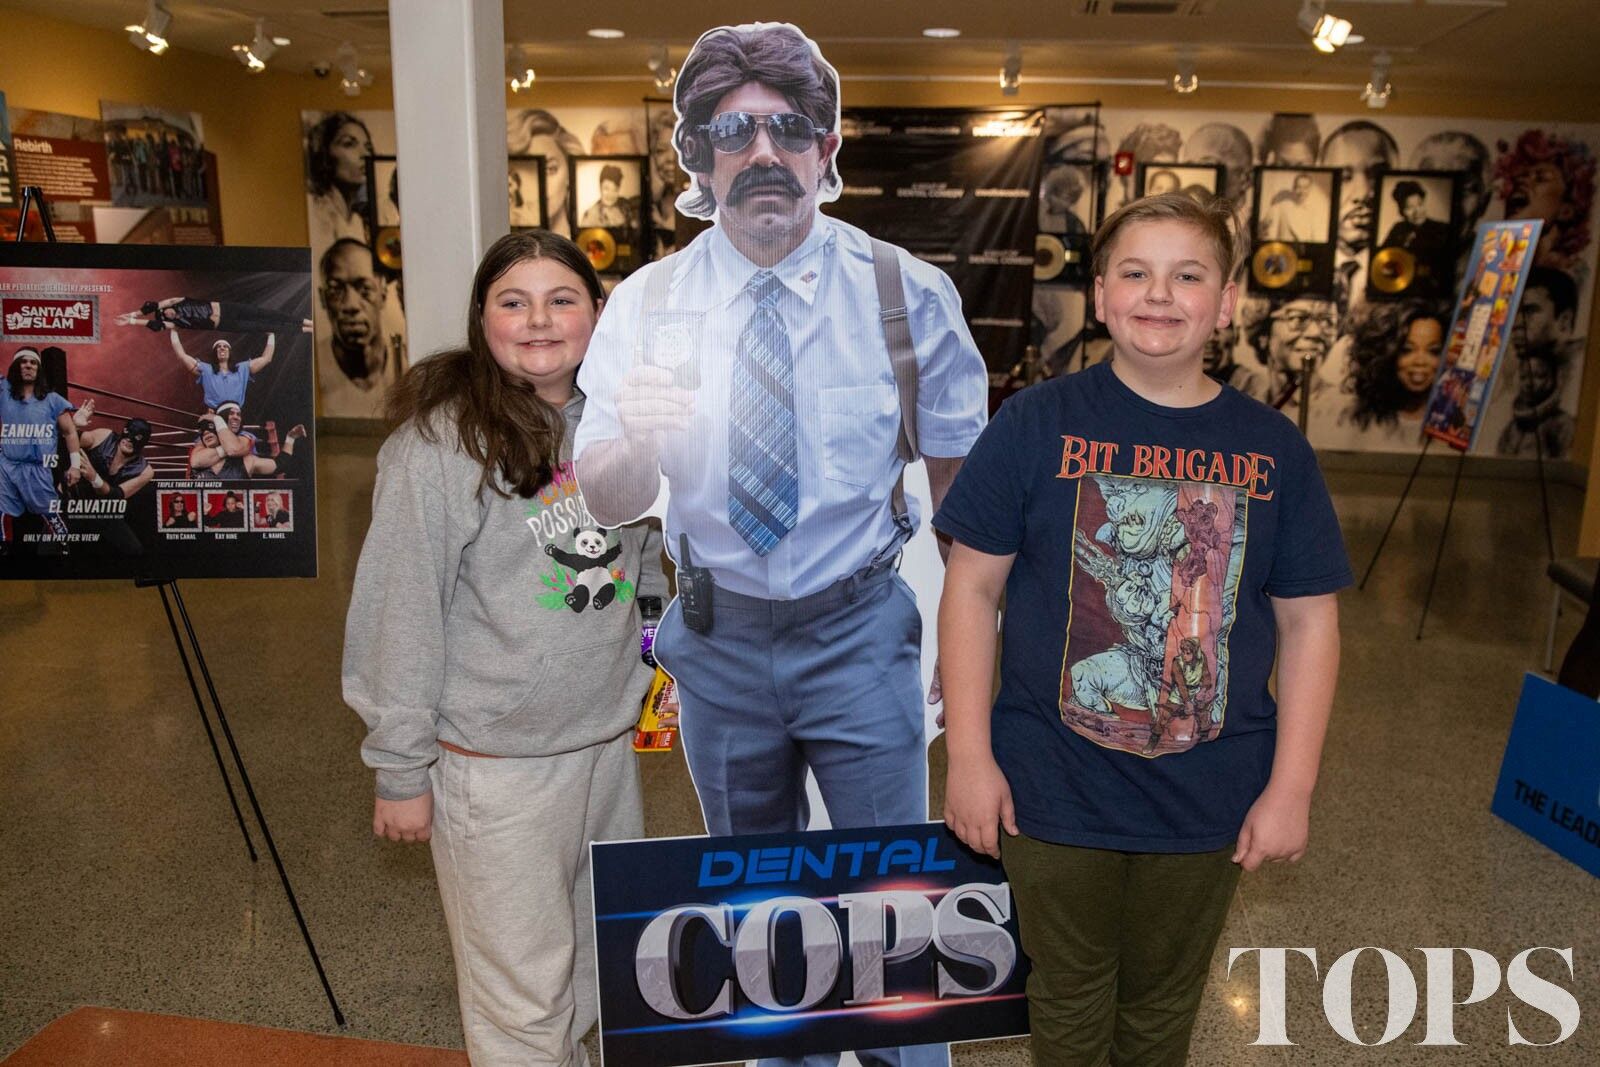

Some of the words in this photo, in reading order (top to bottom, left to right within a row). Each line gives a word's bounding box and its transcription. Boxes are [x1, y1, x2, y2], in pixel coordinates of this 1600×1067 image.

[21, 305, 64, 317] SANTA
[33, 317, 74, 329] SLAM
[0, 423, 54, 438] EANUMS
[42, 454, 59, 468] VS
[1056, 435, 1119, 479] BIT
[1131, 444, 1276, 501] BRIGADE
[48, 499, 63, 513] EL
[67, 499, 128, 513] CAVATITO
[526, 495, 598, 547] POSSIB
[23, 533, 41, 542] ONLY
[42, 533, 51, 542] ON
[53, 533, 66, 541] PAY
[67, 533, 80, 541] PER
[81, 533, 100, 541] VIEW
[1514, 778, 1549, 815] THE
[1549, 801, 1600, 849] LEAD
[699, 837, 957, 887] DENTAL
[635, 882, 1017, 1019] COPS
